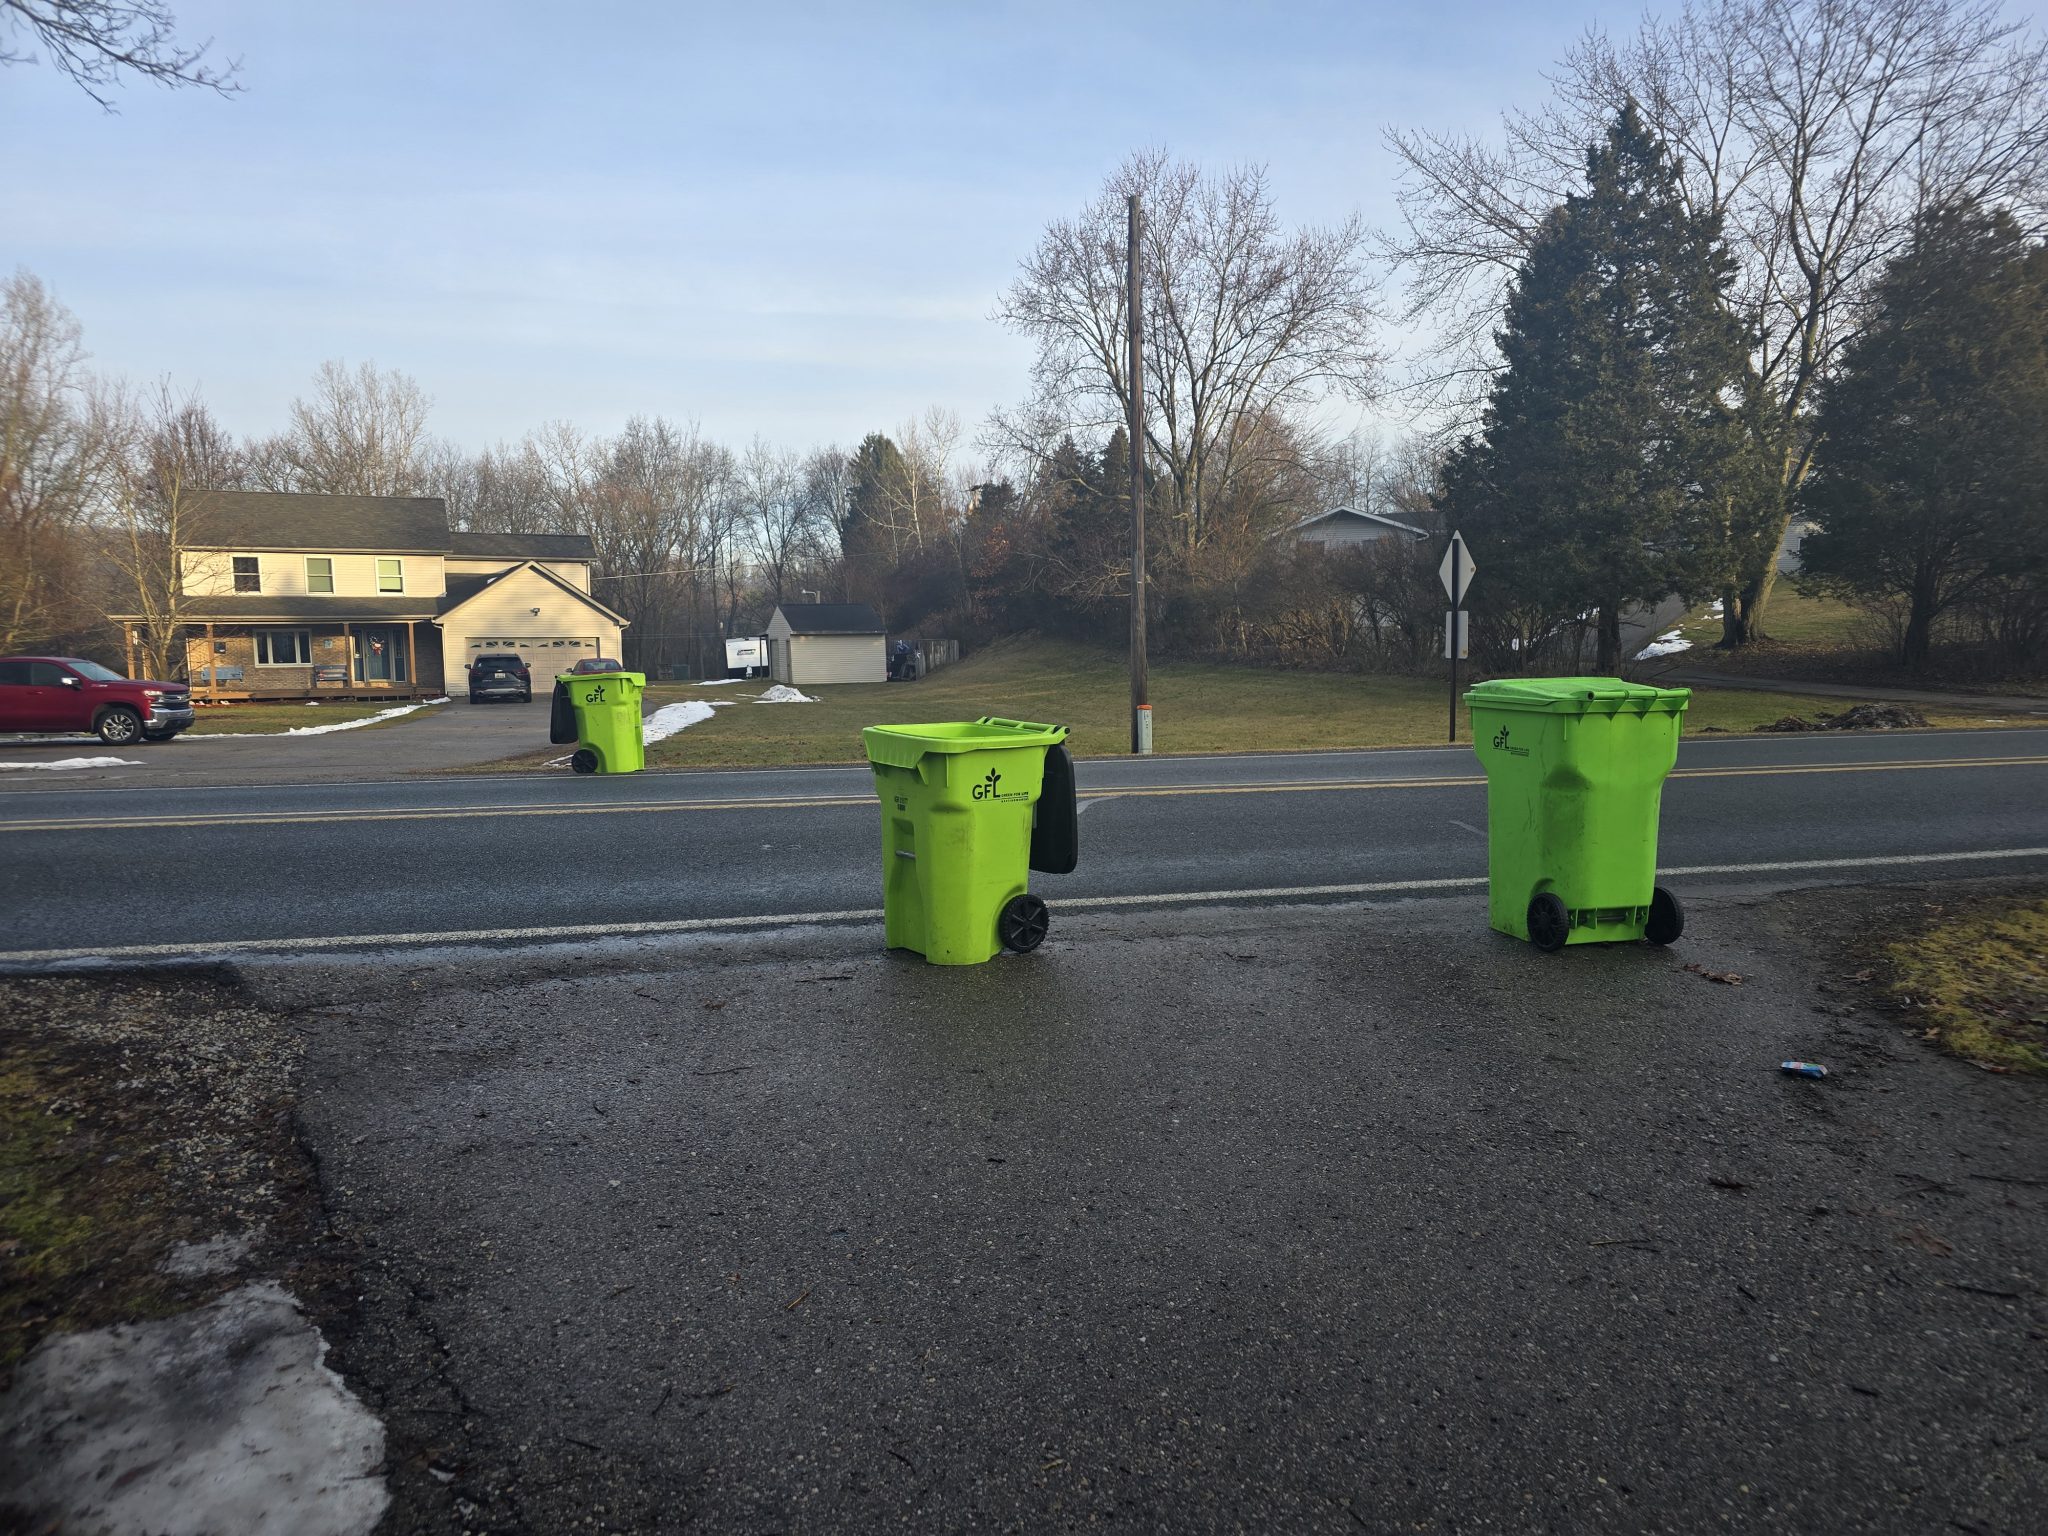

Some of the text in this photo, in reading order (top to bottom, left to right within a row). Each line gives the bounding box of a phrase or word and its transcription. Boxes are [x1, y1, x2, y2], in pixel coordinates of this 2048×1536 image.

[586, 688, 606, 703] GFL
[1493, 731, 1510, 749] GFL
[972, 774, 1001, 800] GFL
